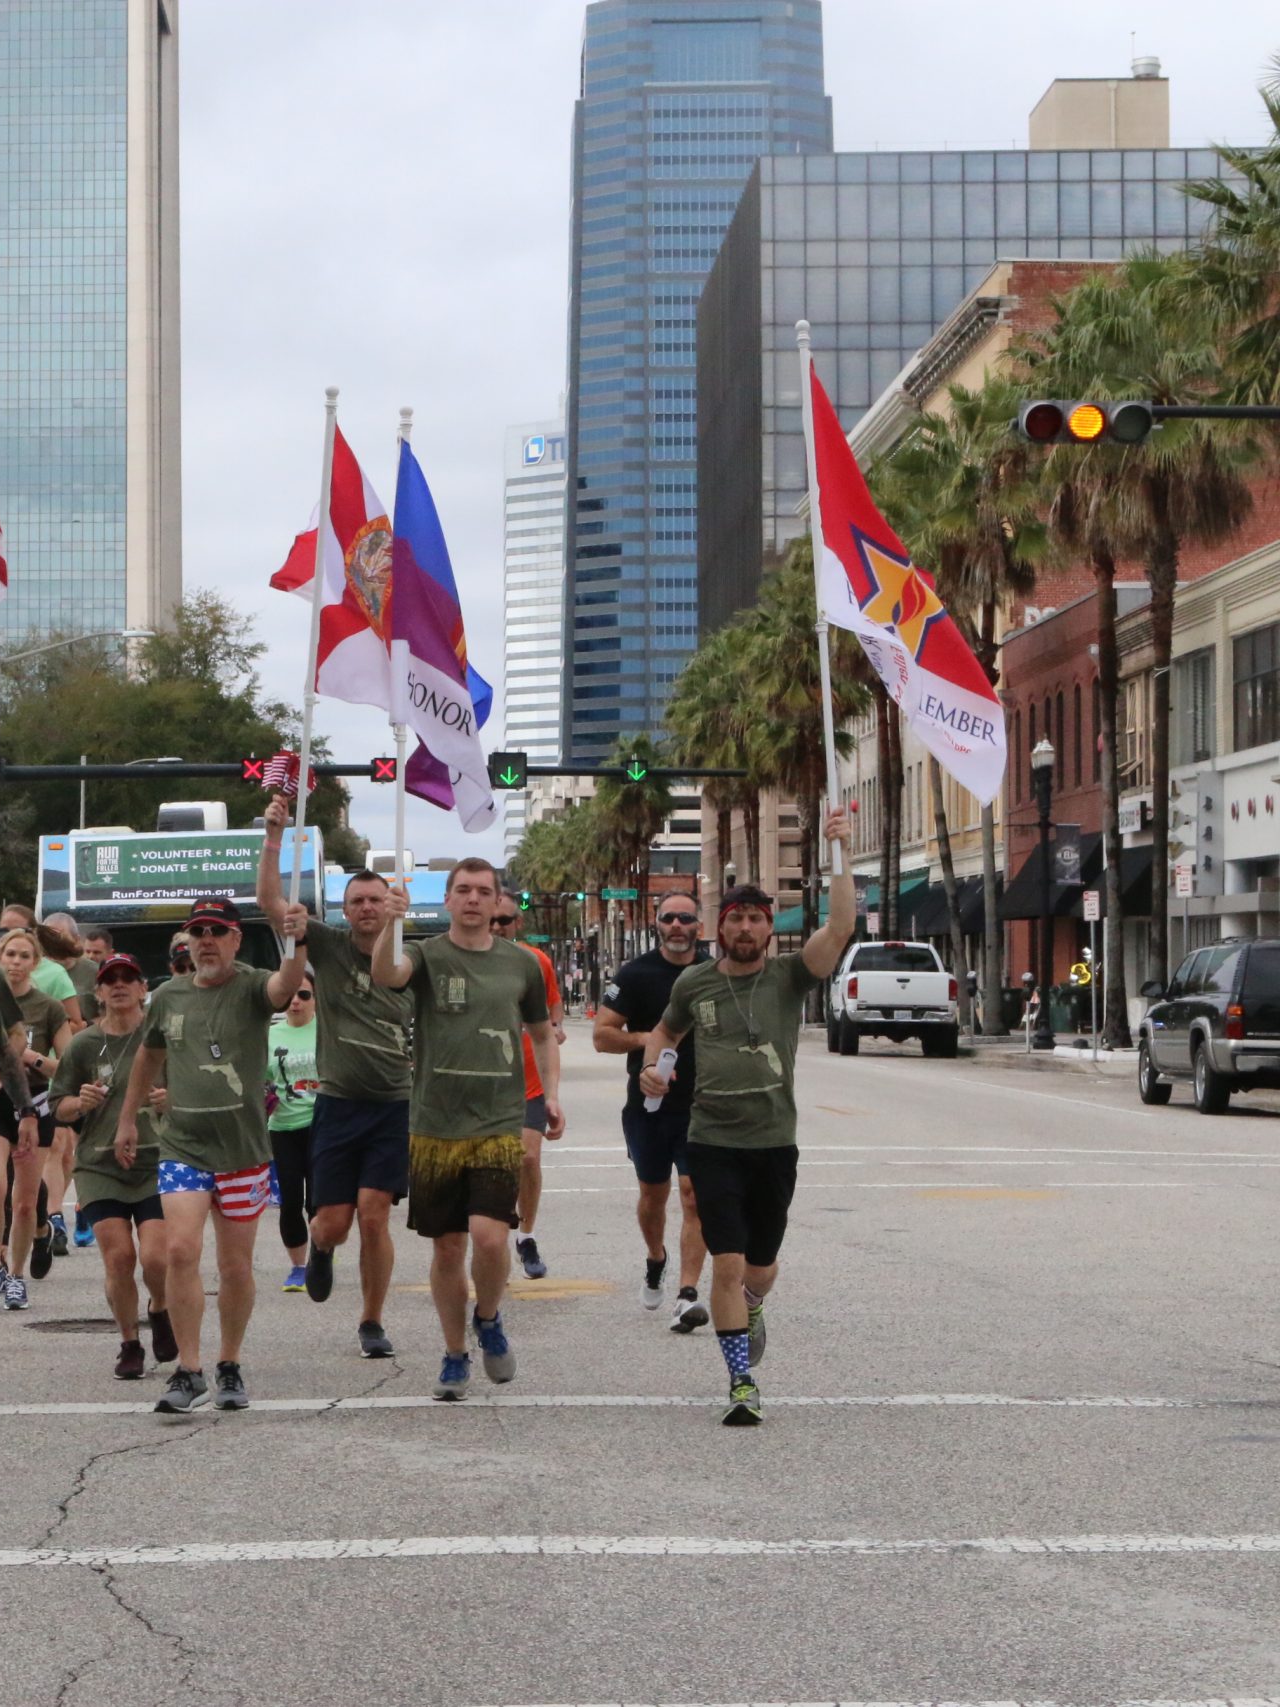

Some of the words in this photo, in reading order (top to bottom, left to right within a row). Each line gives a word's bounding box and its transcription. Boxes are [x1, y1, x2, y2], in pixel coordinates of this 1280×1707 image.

[919, 693, 997, 746] EMBER
[96, 846, 119, 859] RUN
[141, 848, 212, 860] VOLUNTEER
[225, 848, 251, 857] RUN
[140, 864, 188, 873] DONATE
[202, 862, 252, 871] ENGAGE
[112, 888, 235, 899] RunForTheFallen.org
